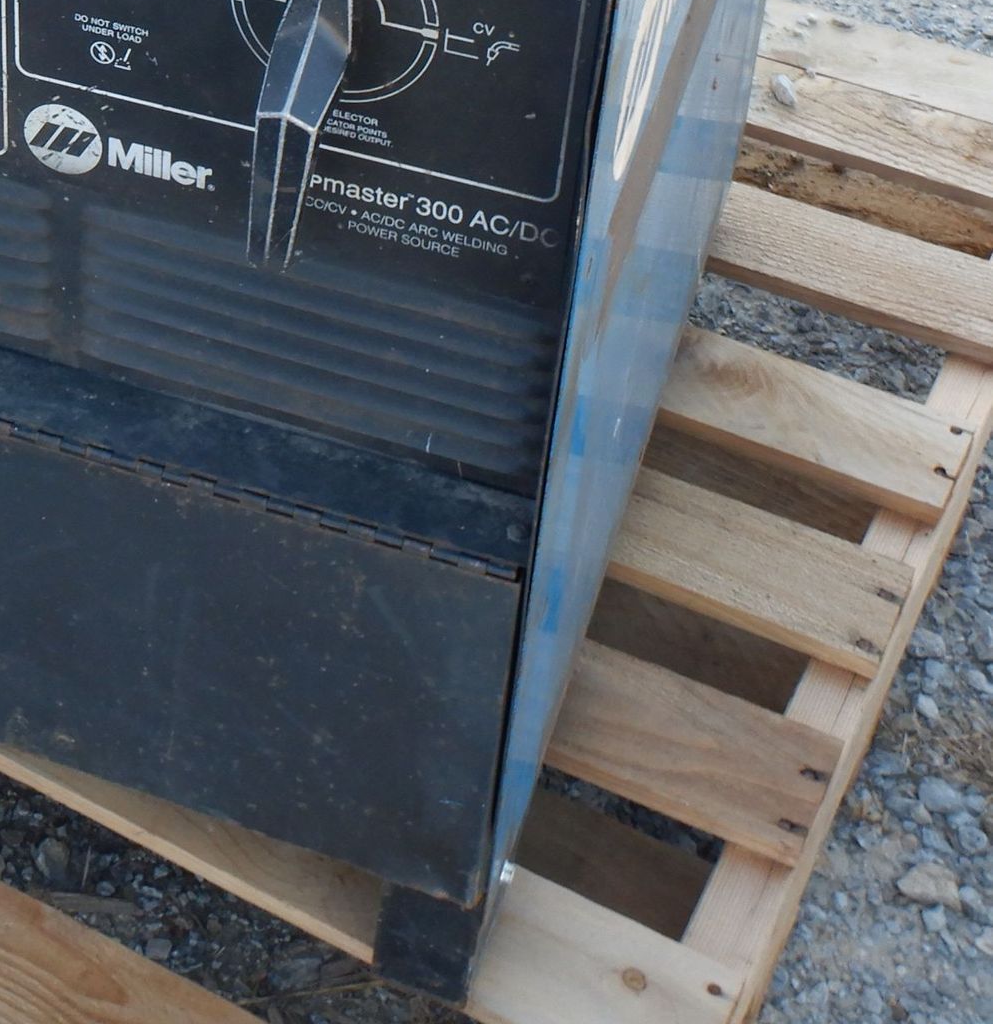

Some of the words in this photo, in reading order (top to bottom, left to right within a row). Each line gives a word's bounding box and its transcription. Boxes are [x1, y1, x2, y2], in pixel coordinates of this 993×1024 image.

[74, 13, 88, 24] DO
[90, 17, 110, 28] NOT
[112, 22, 149, 37] SWITCH
[82, 24, 114, 38] UNDER
[116, 31, 142, 44] LOAD
[472, 22, 496, 37] CV
[357, 125, 388, 139] POINTS
[108, 136, 212, 190] Miller
[361, 210, 406, 230] AC/DC
[408, 222, 439, 238] ARC
[442, 230, 509, 256] WELDING
[416, 196, 464, 225] 300
[469, 210, 558, 248] AC/DC
[348, 220, 398, 242] POWER
[400, 234, 461, 259] SOURCE
